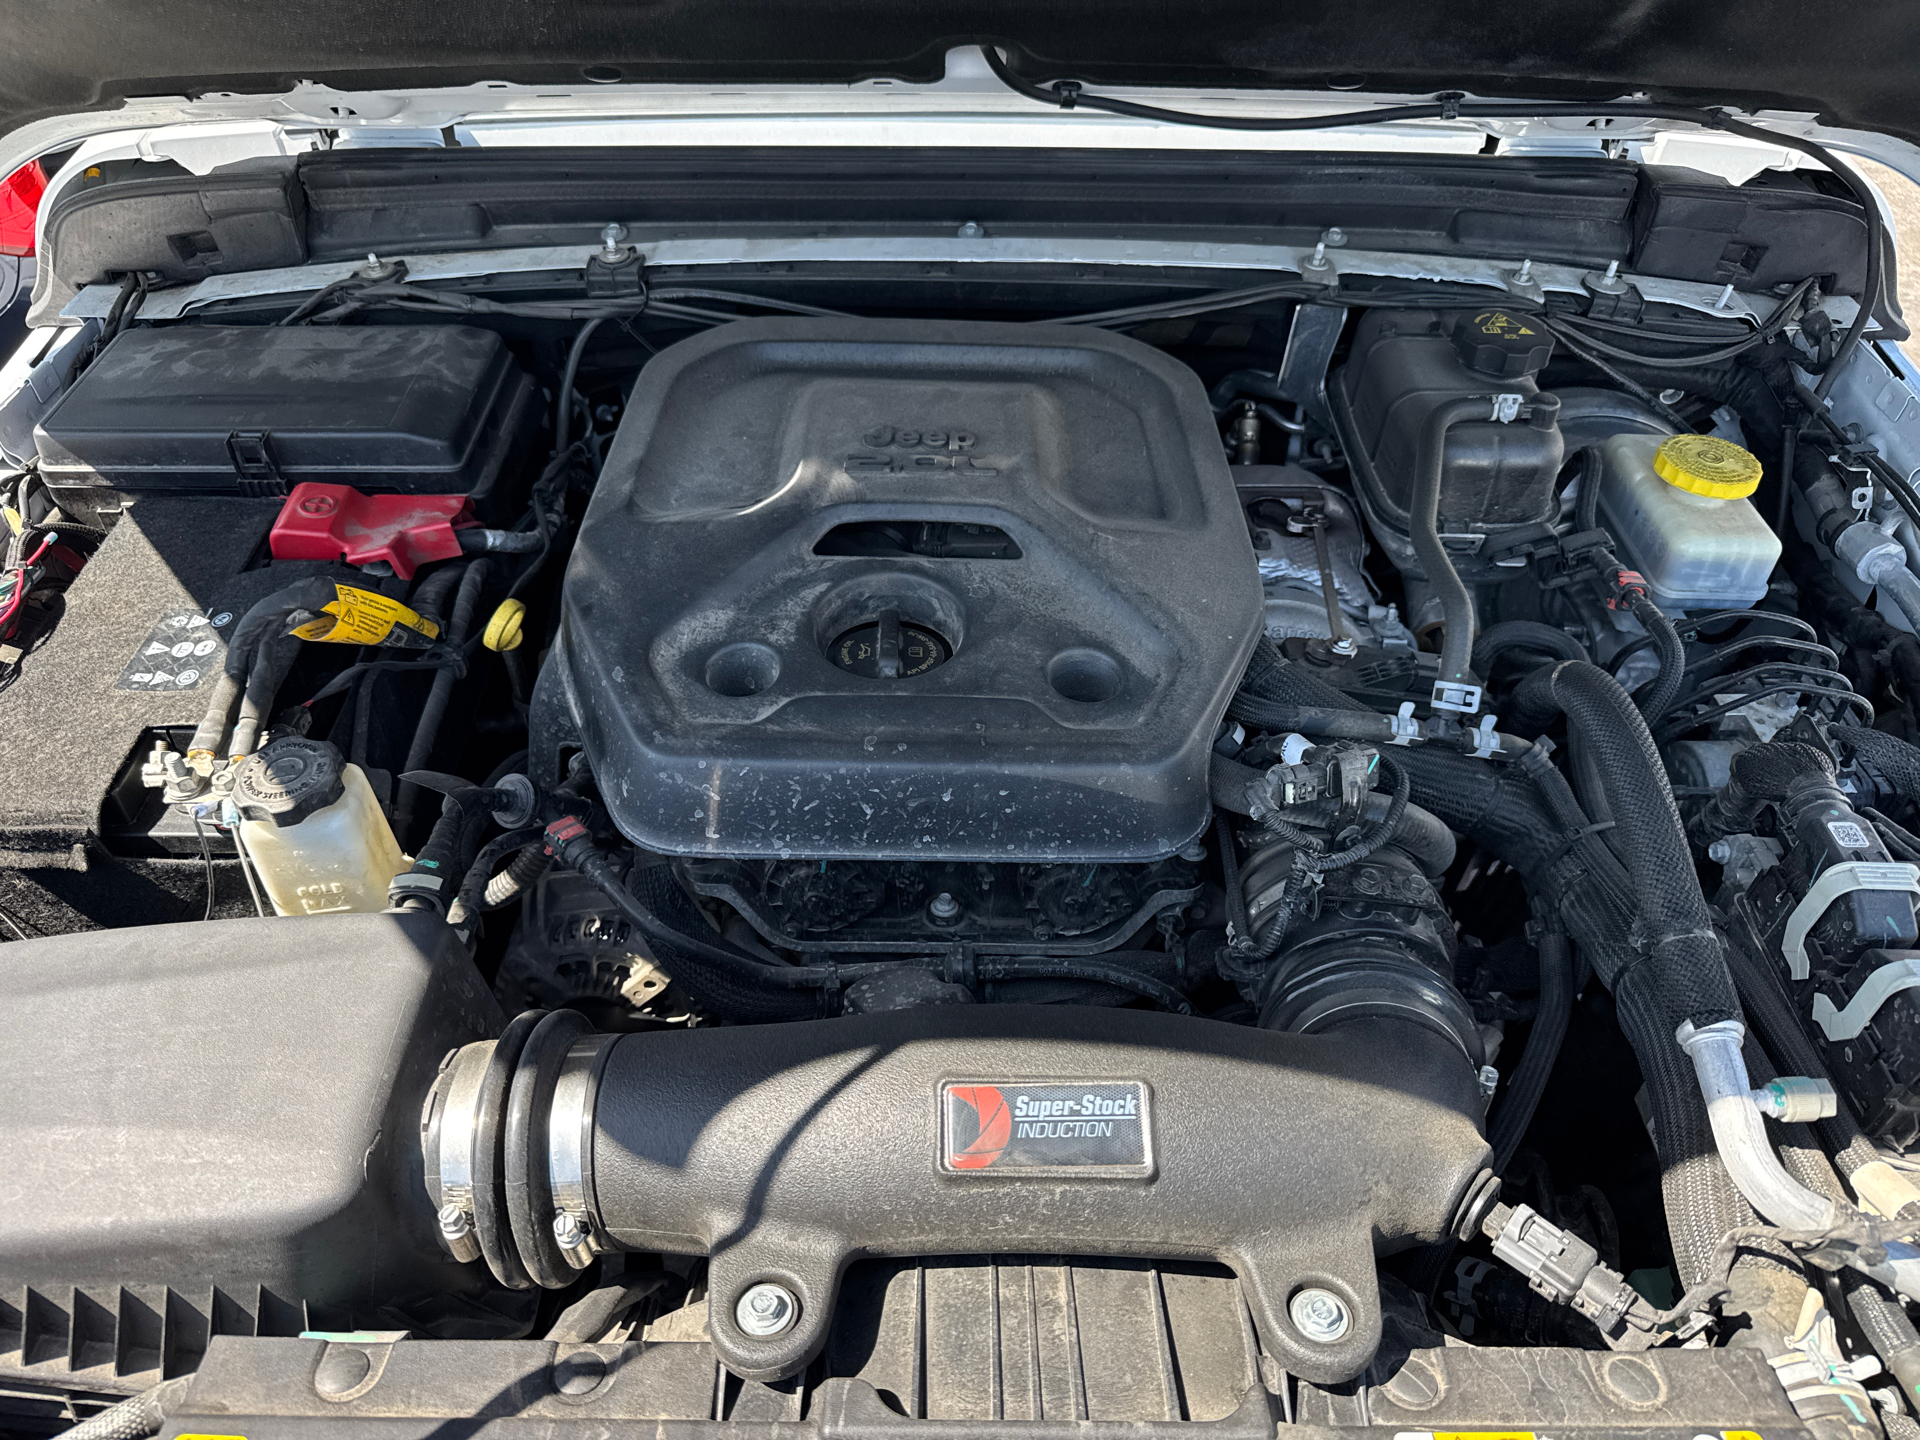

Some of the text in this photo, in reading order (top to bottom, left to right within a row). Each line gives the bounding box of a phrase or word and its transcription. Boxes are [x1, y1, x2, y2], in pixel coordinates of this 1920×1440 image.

[863, 426, 976, 451] Jeep
[844, 453, 998, 476] 2.0L
[262, 781, 310, 799] STEERING
[296, 882, 343, 897] COLD
[1015, 1094, 1137, 1120] Super-Stock
[1017, 1121, 1113, 1139] INDUCTION
